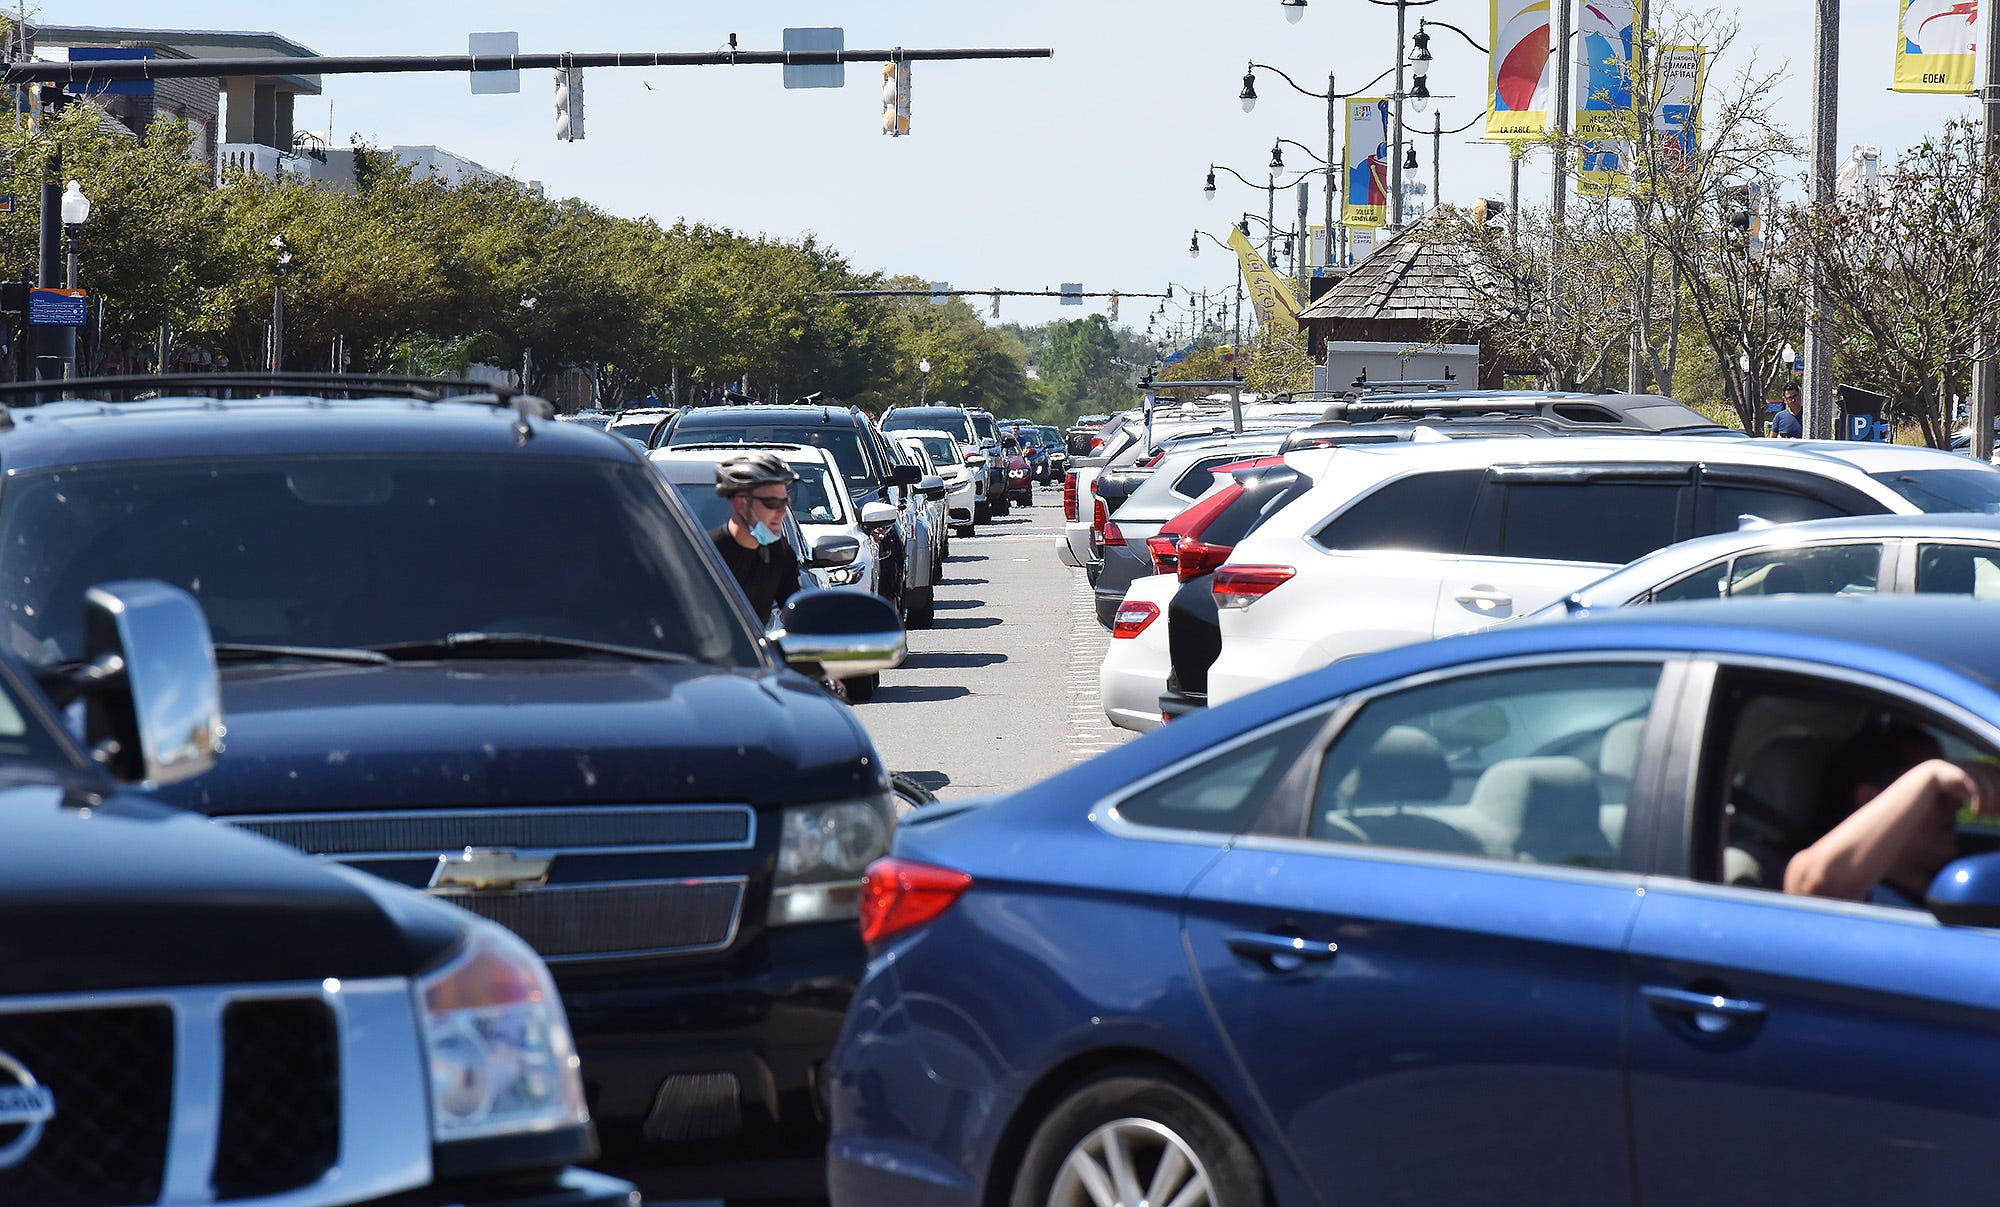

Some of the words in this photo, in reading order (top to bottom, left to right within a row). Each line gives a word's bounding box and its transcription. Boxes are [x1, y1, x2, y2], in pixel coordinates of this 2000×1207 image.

[1663, 61, 1696, 69] SUMMER
[1663, 70, 1696, 78] CAPITAL
[1854, 416, 1867, 436] P
